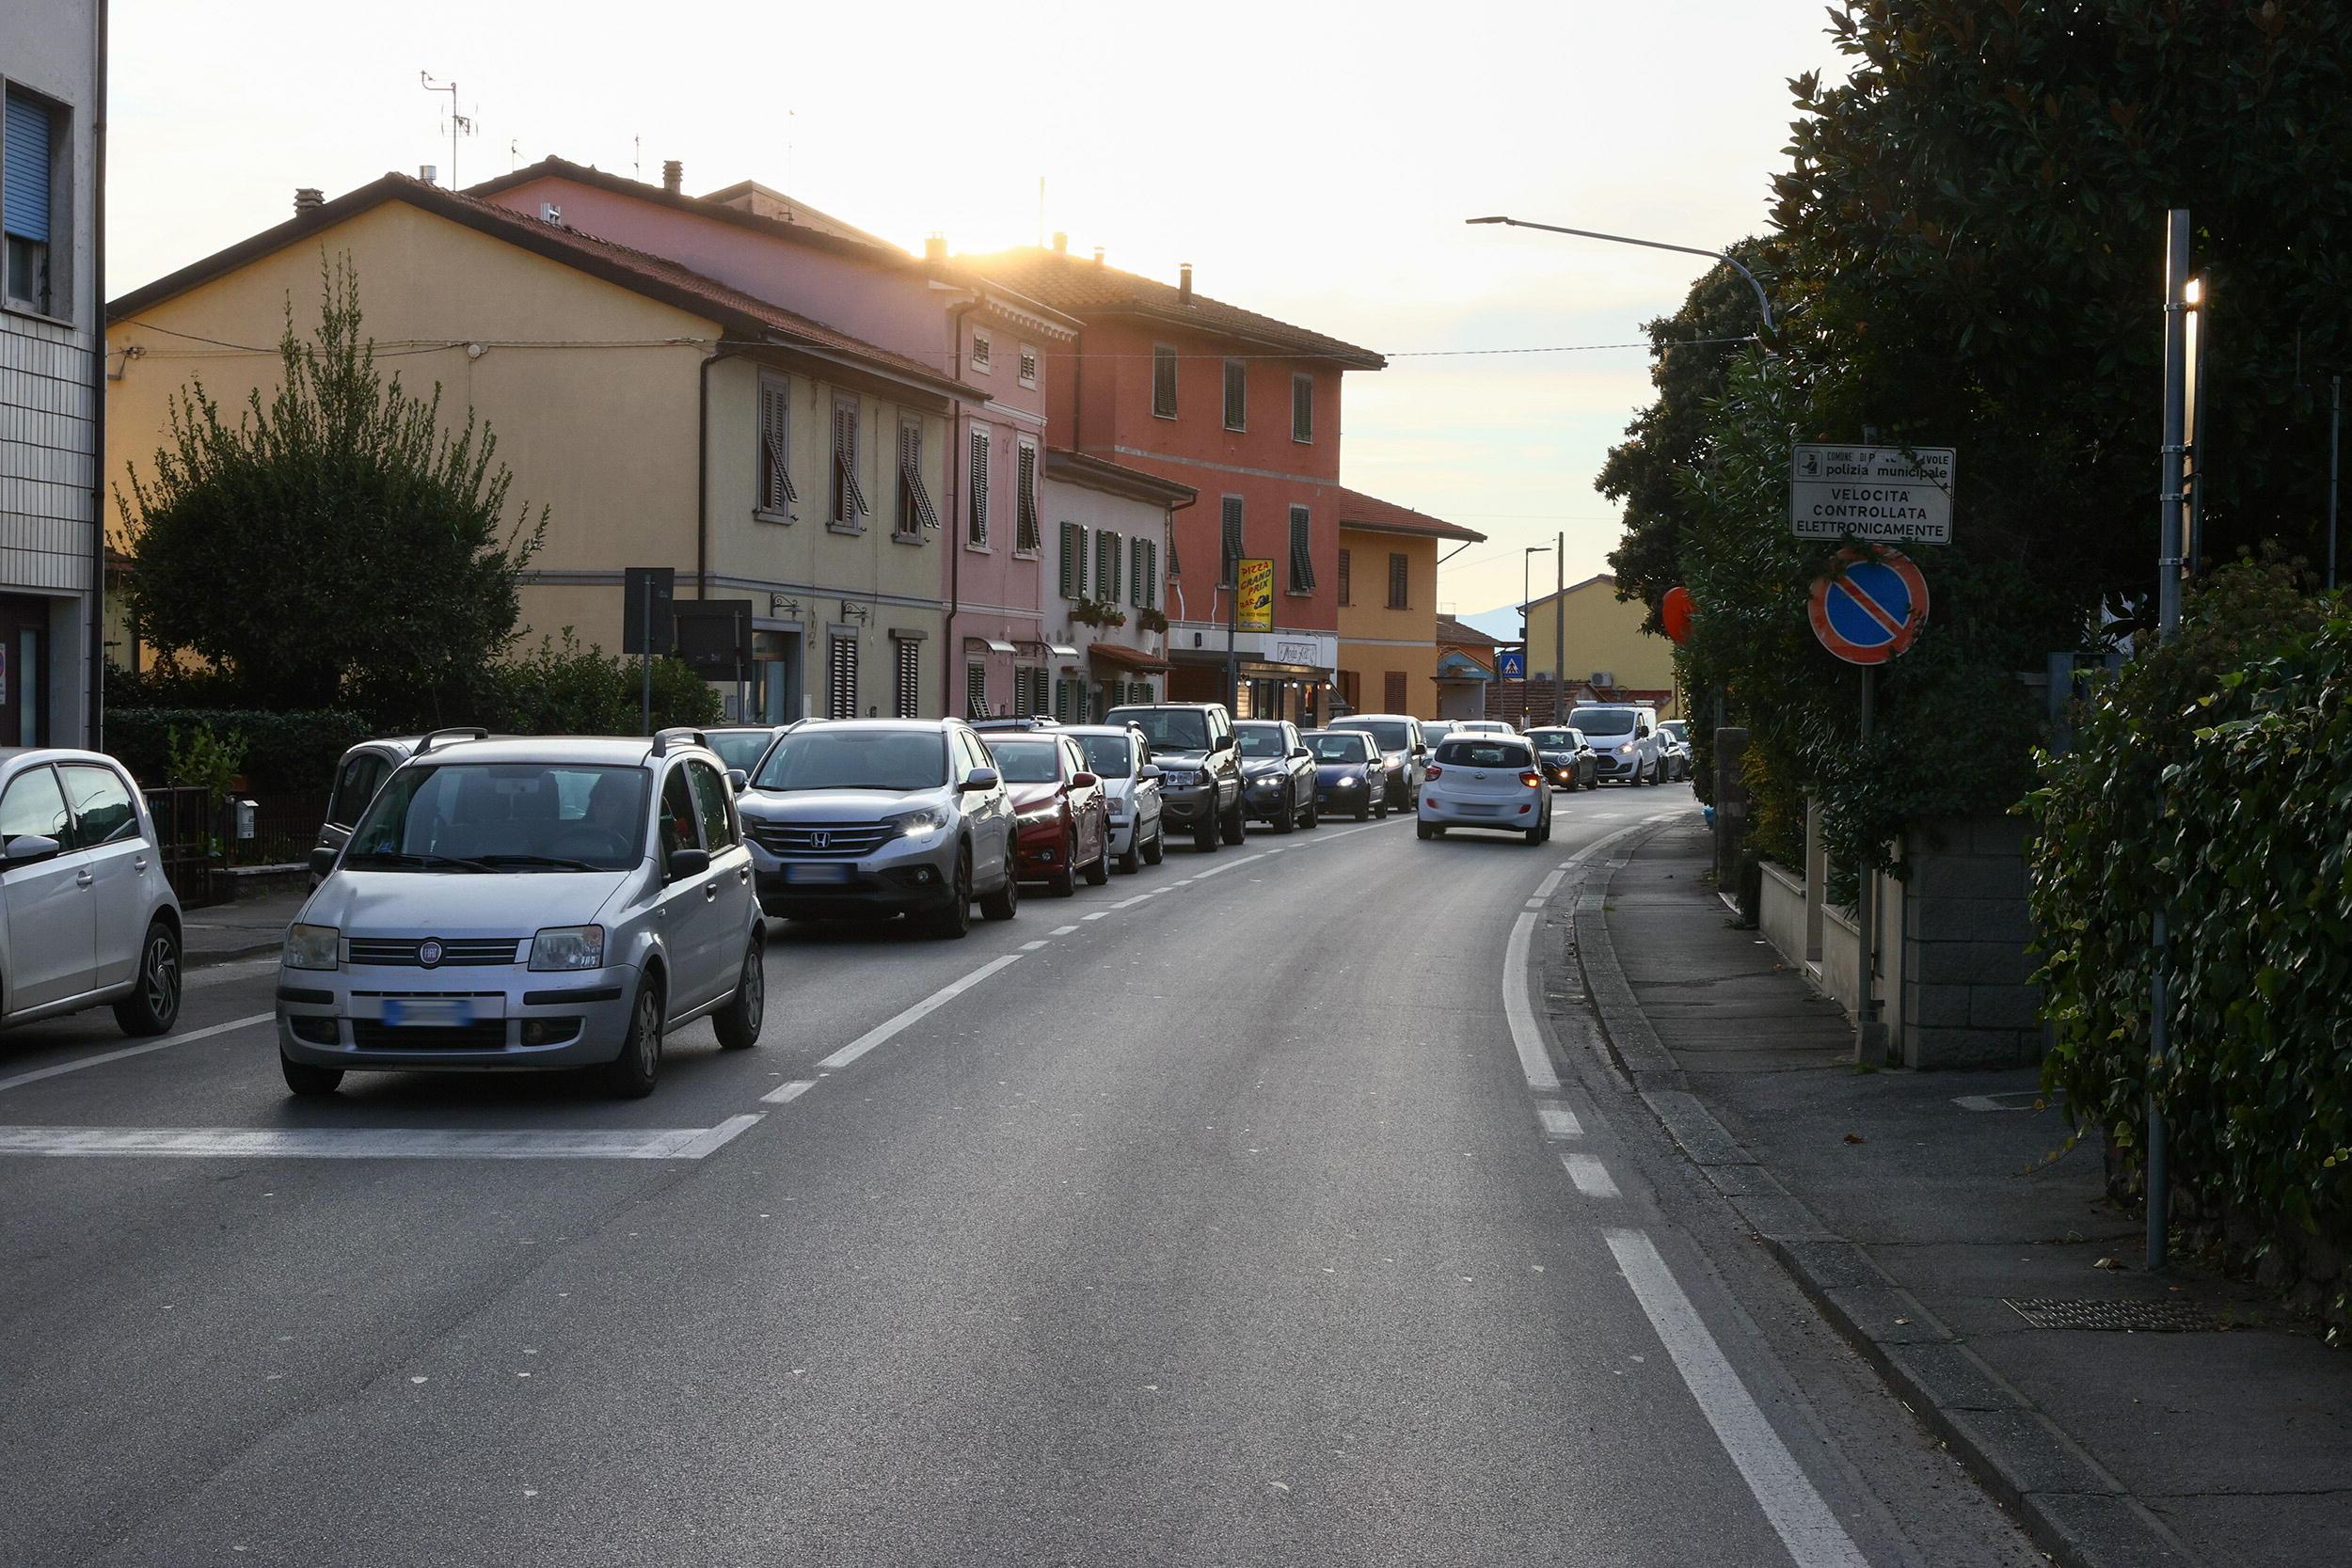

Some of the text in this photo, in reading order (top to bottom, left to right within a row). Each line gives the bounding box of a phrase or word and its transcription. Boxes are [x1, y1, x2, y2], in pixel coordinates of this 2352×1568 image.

[1827, 451, 1852, 462] COMUNE
[1859, 451, 1867, 462] DI
[1826, 465, 1947, 481] polizia municipale
[1813, 504, 1928, 520] CONTROLLATA
[1797, 520, 1944, 537] ELETTRONICAMENTE
[1241, 561, 1269, 576] PIZZA
[1240, 569, 1272, 591] GRAND
[1248, 579, 1269, 596] PRIX
[1239, 598, 1255, 610] BAR
[424, 947, 437, 958] FIAT
